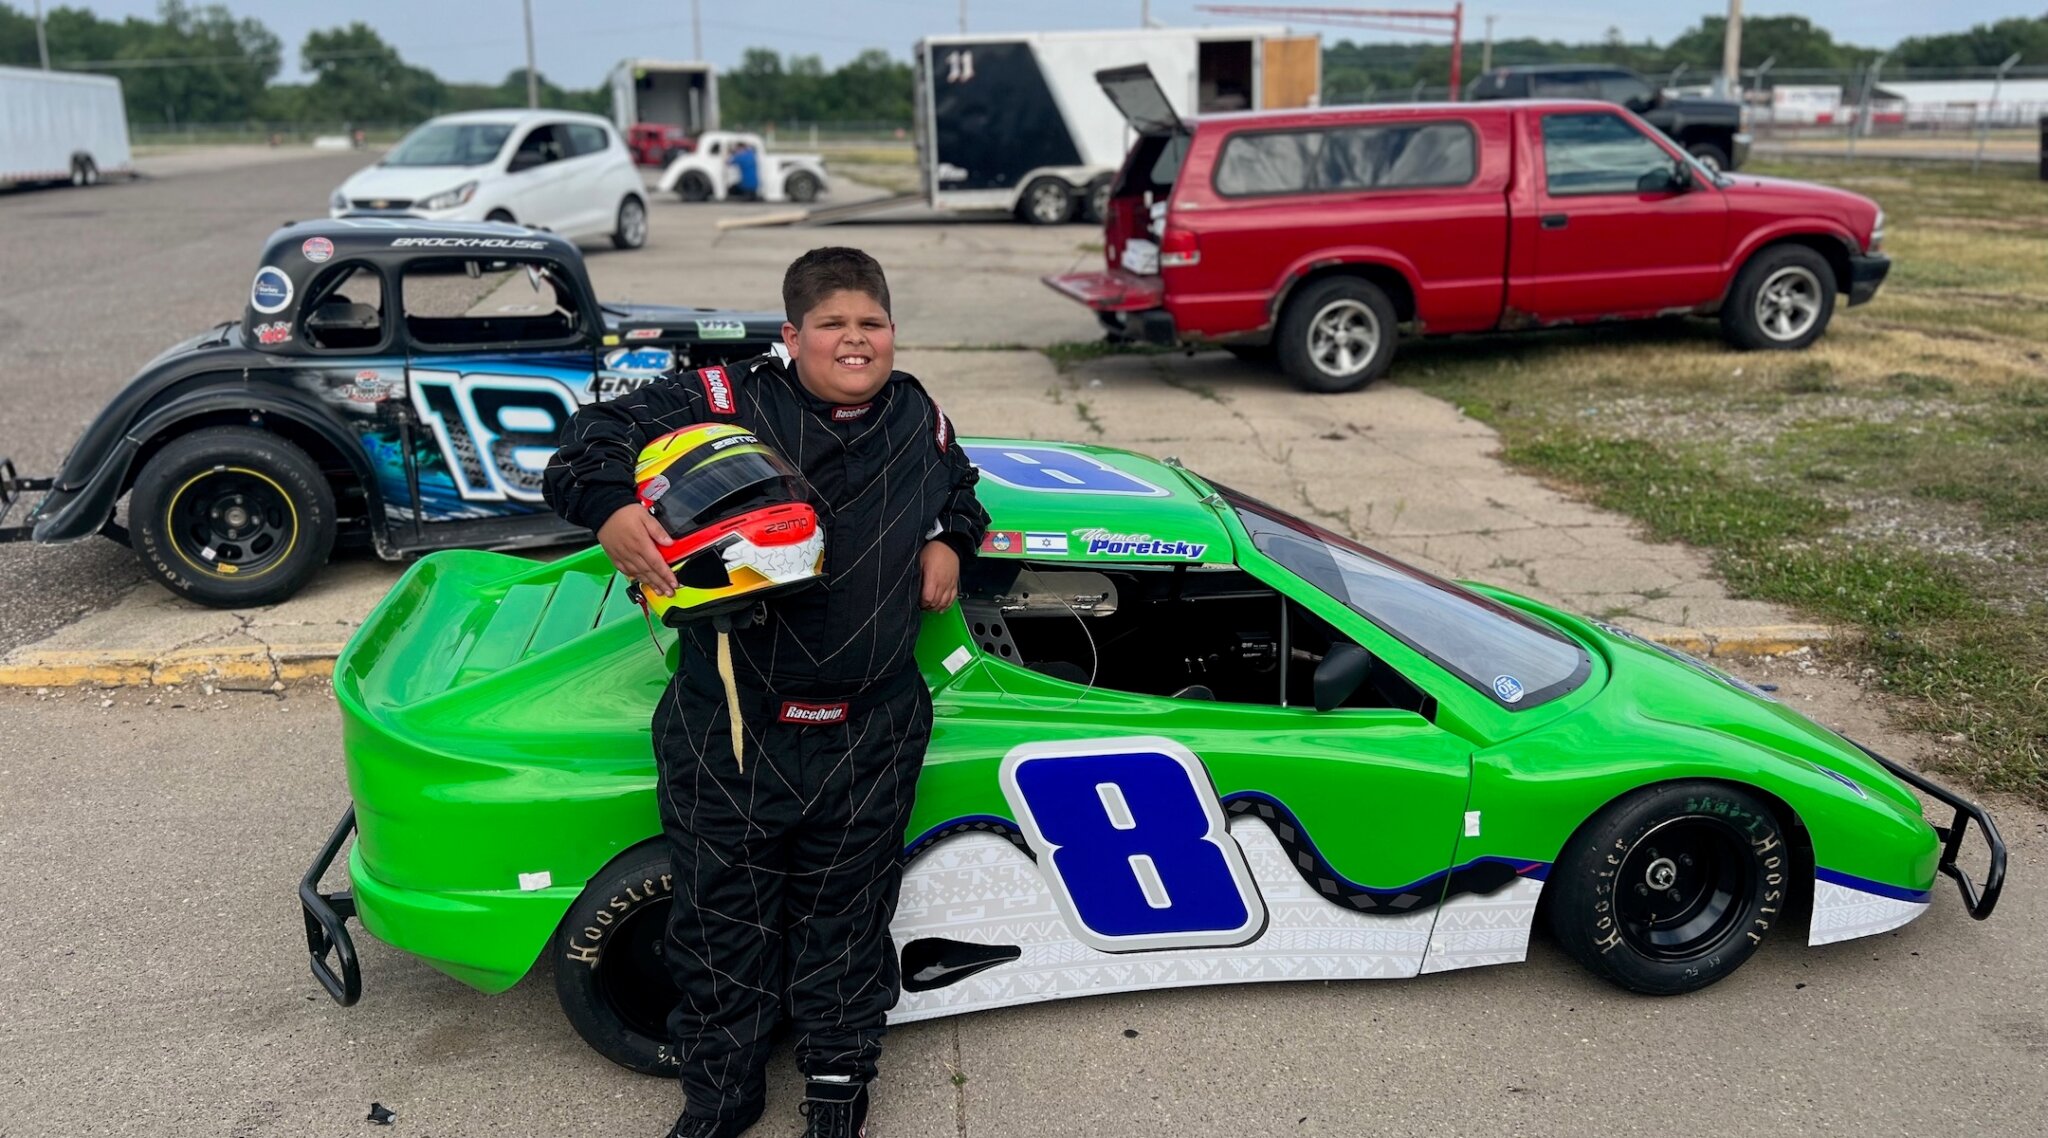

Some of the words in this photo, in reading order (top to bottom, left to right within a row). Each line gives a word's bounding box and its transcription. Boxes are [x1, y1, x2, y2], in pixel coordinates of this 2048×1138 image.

[390, 237, 549, 250] BROCKHOUSE
[409, 370, 582, 500] 18
[711, 434, 758, 450] zamp
[962, 444, 1173, 497] 8
[764, 516, 809, 534] zamp
[1087, 540, 1206, 558] Poretsky
[1497, 679, 1518, 695] OK
[786, 706, 843, 721] RaceQuip
[1008, 746, 1254, 942] 8
[1746, 830, 1783, 945] Hoosier
[566, 873, 673, 969] Hoosier
